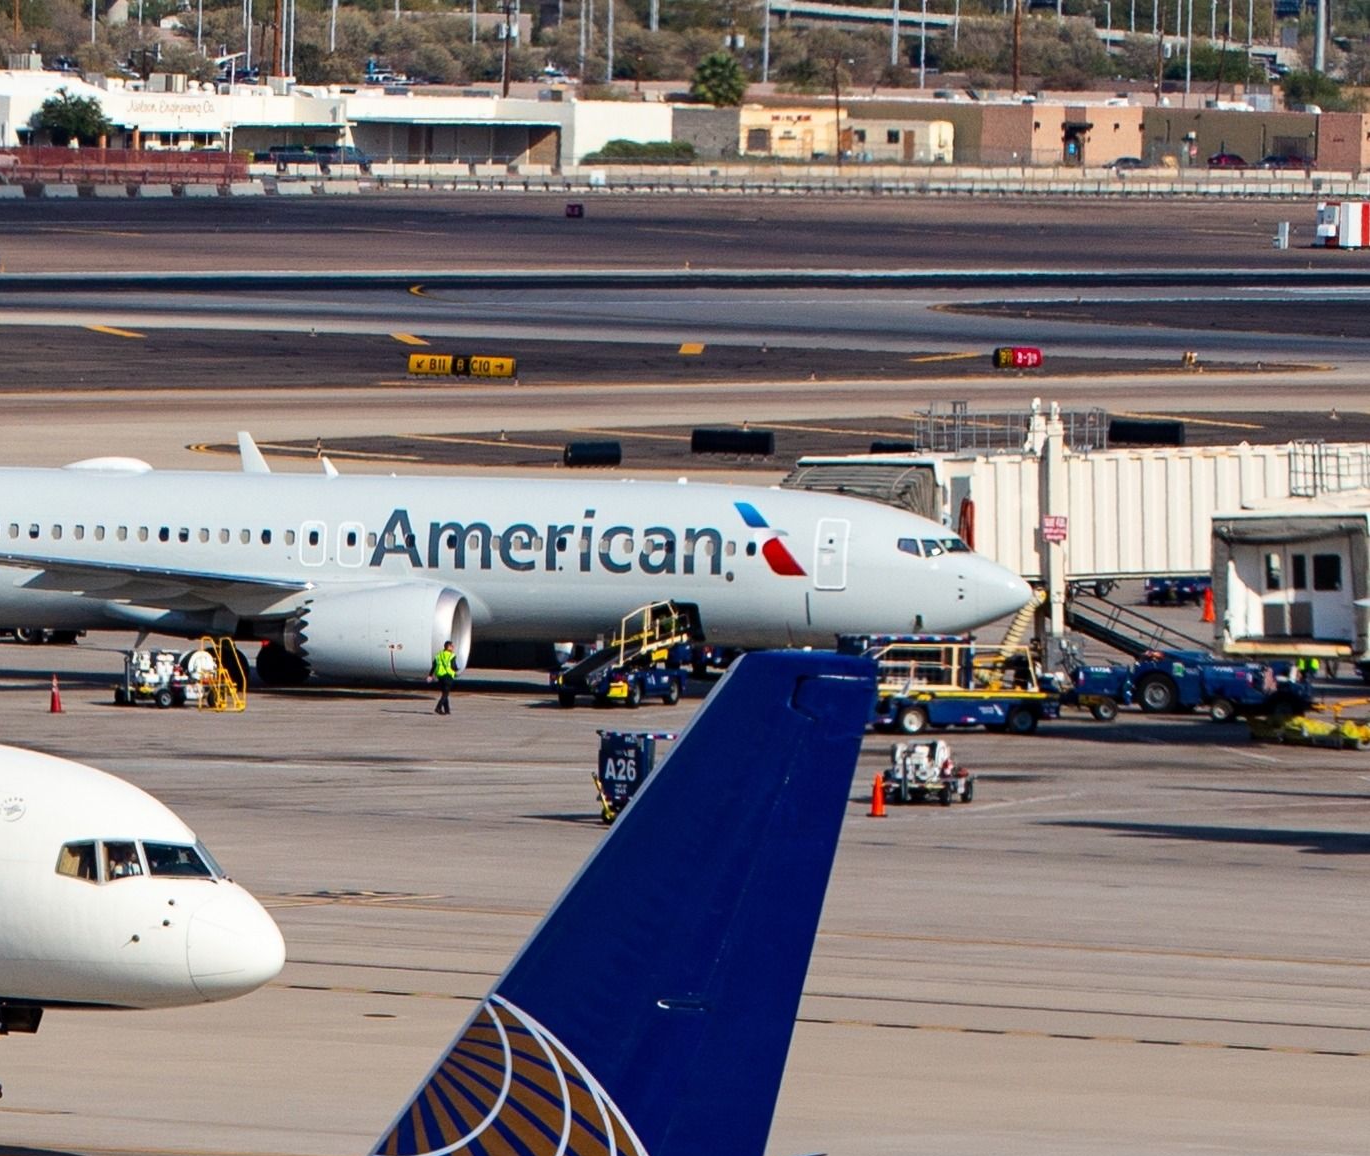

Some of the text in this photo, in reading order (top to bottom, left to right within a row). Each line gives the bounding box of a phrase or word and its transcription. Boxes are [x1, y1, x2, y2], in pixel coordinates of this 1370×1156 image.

[429, 358, 446, 372] B11
[368, 508, 723, 577] American
[604, 757, 637, 782] A26
